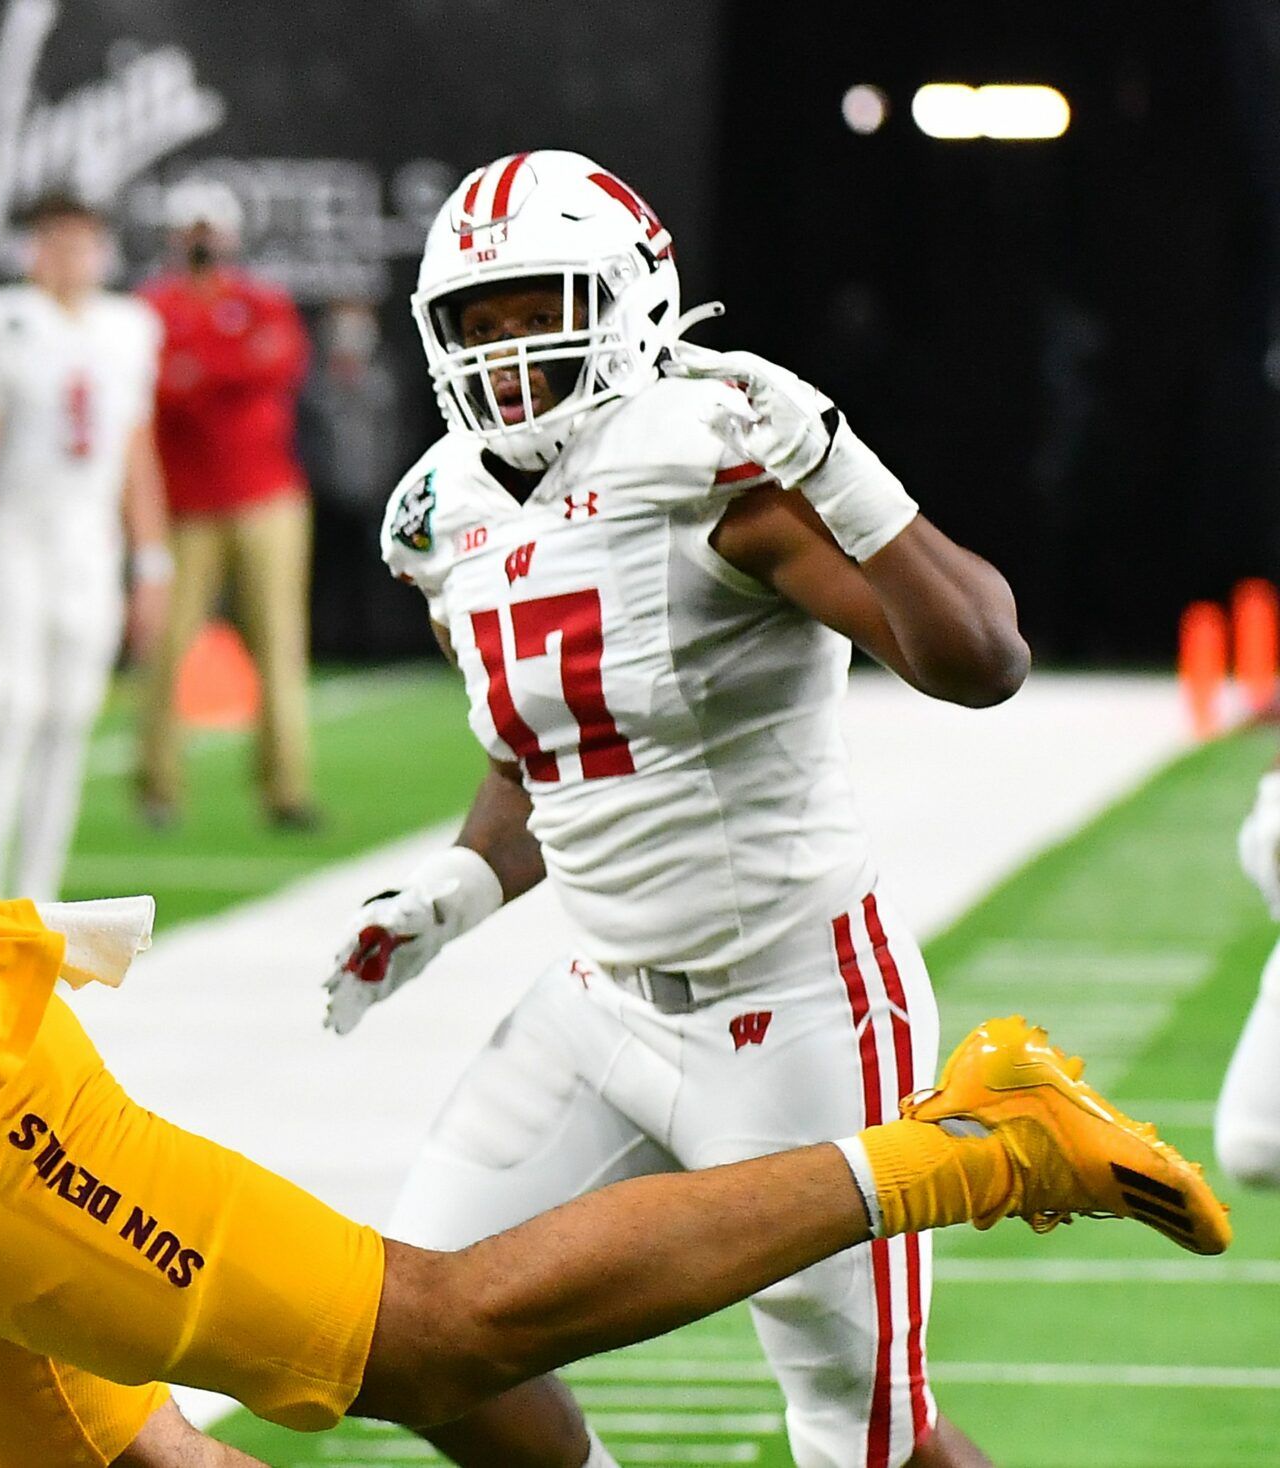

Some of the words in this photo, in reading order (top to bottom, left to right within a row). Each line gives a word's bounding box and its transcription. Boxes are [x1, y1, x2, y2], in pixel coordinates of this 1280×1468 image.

[504, 540, 537, 588] W
[470, 588, 637, 783] 17
[728, 1010, 773, 1052] W
[8, 1112, 122, 1225] DEVILS
[118, 1205, 205, 1289] SUN
